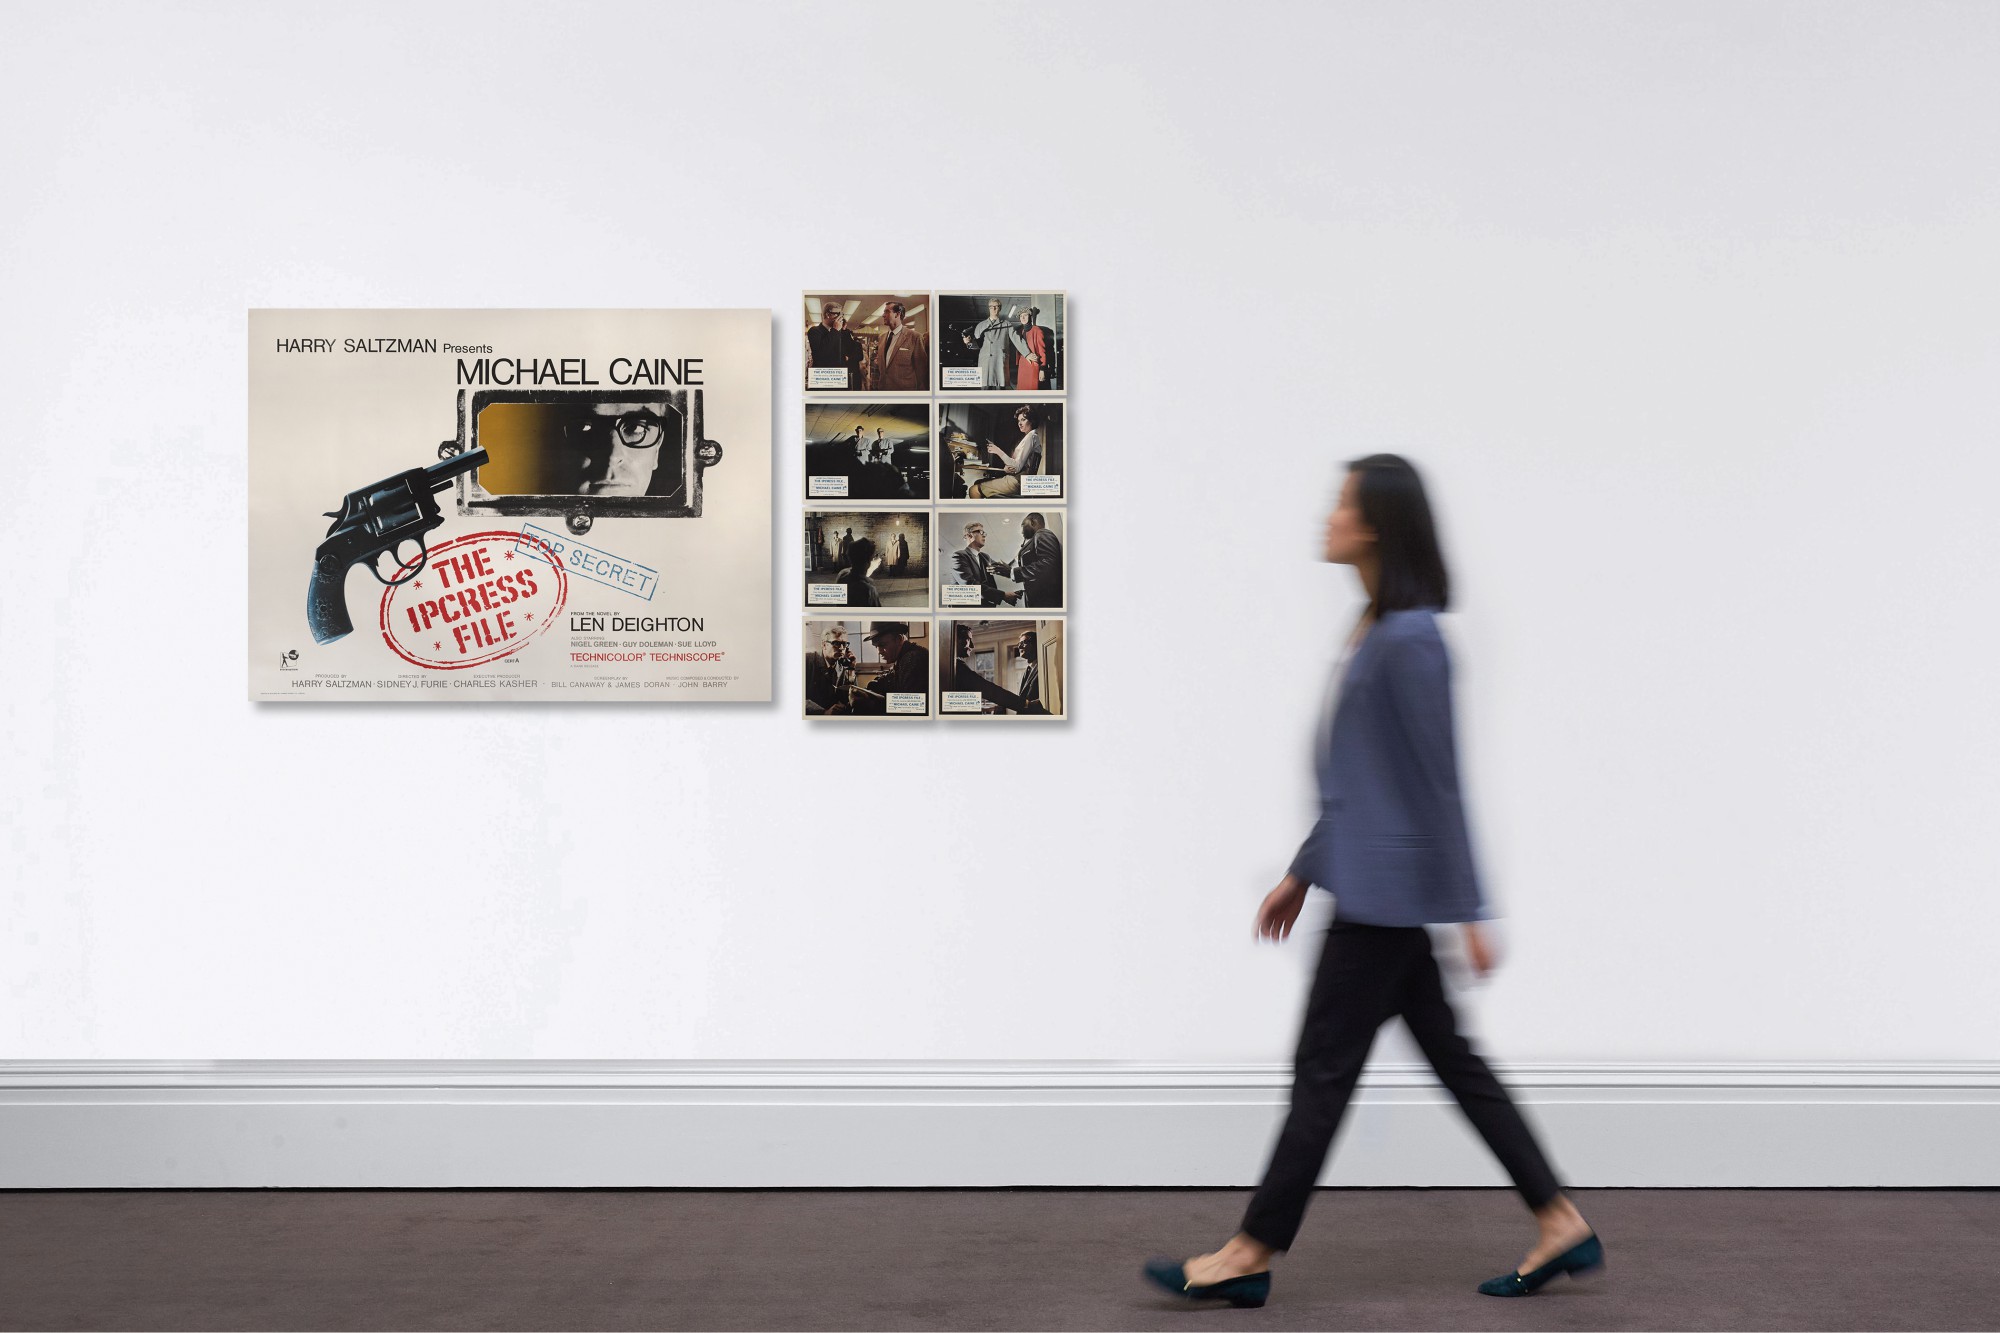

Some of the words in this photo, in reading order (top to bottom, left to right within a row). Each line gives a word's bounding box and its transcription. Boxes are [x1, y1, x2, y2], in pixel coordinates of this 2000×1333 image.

[276, 339, 336, 353] HARRY
[344, 339, 436, 353] SALTZMAN
[443, 344, 493, 353] Presents
[457, 358, 599, 385] MICHAEL
[609, 358, 703, 385] CAINE
[432, 548, 495, 588] THE
[524, 532, 565, 557] TOP
[570, 549, 652, 592] SECRET
[407, 569, 538, 632] IPCRESS
[452, 610, 518, 654] FILE
[571, 617, 604, 632] LEN
[612, 617, 704, 632] DEIGHTON
